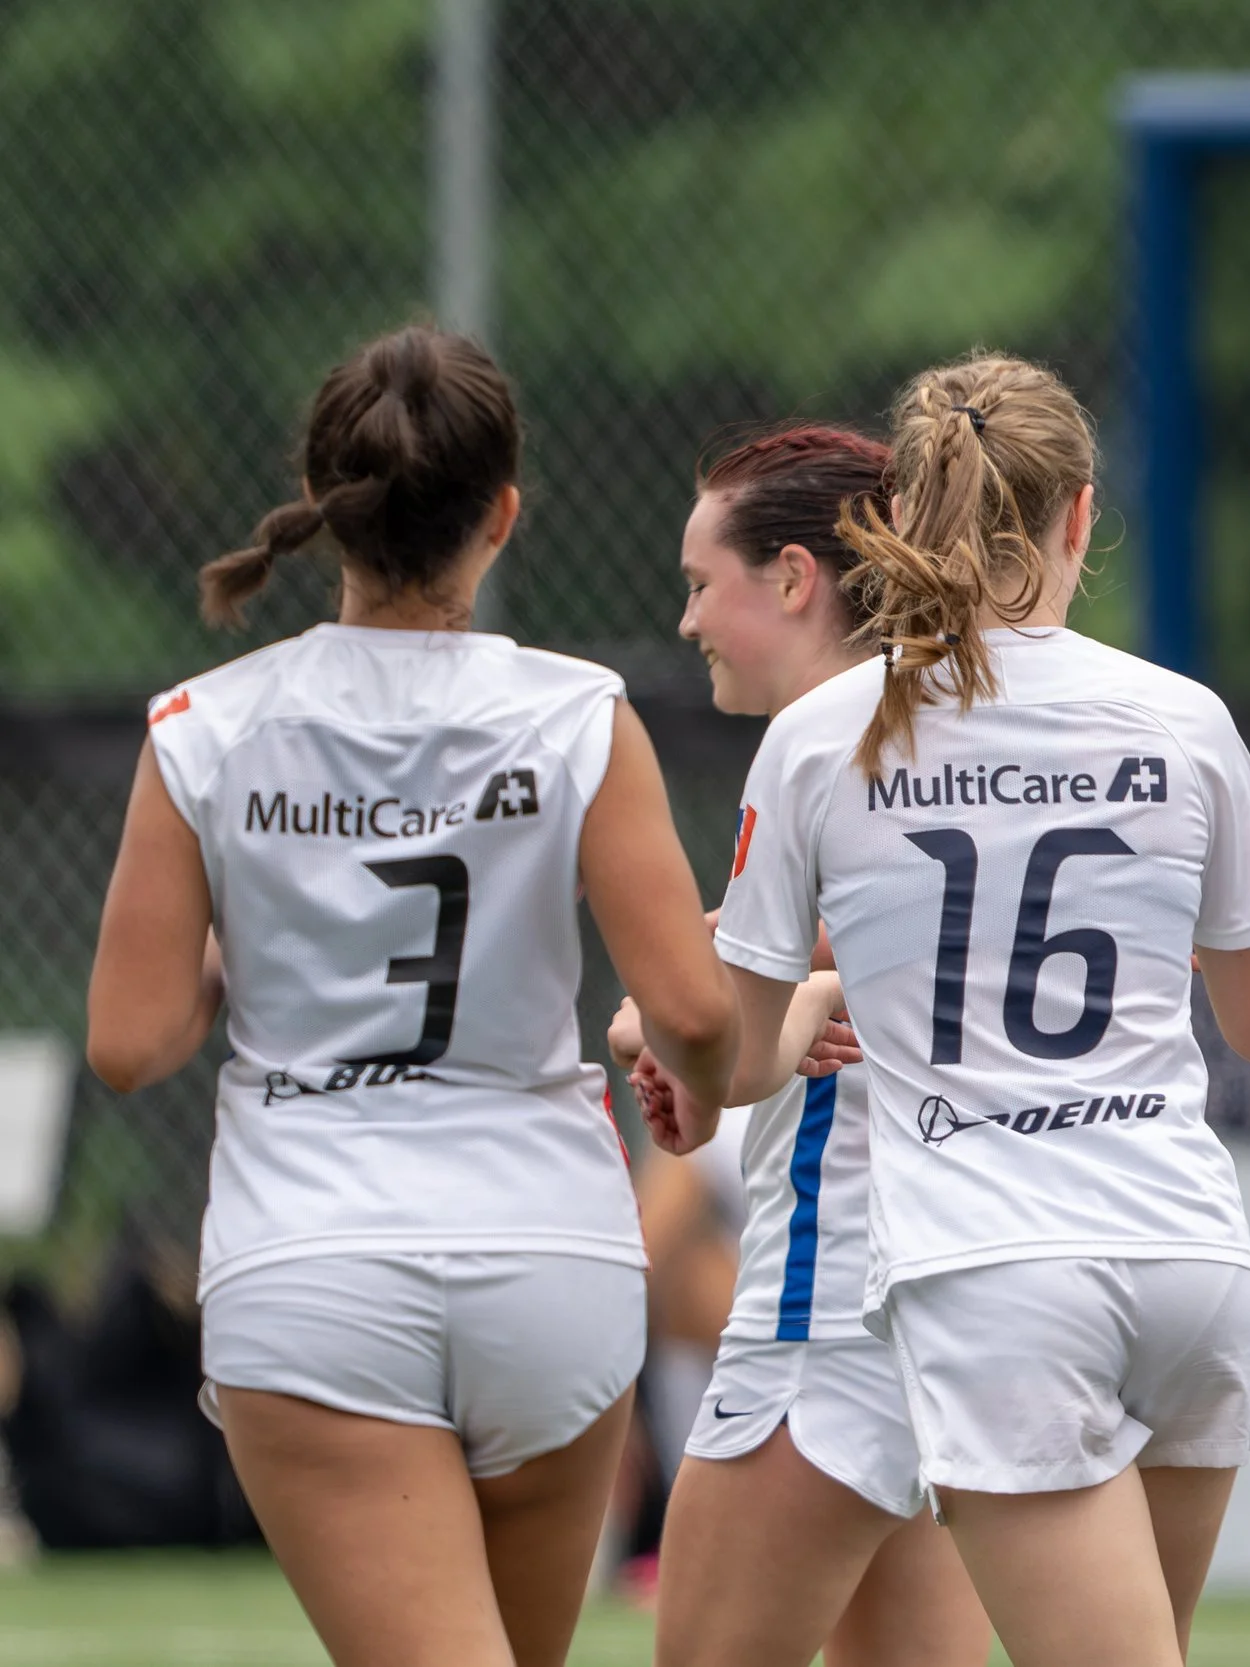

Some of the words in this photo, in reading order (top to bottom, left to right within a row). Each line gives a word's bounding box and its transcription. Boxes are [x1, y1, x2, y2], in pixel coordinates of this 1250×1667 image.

[244, 790, 467, 839] MultiCare
[868, 763, 1097, 812] MultiCare
[335, 854, 469, 1066] 3
[902, 827, 1138, 1066] 16
